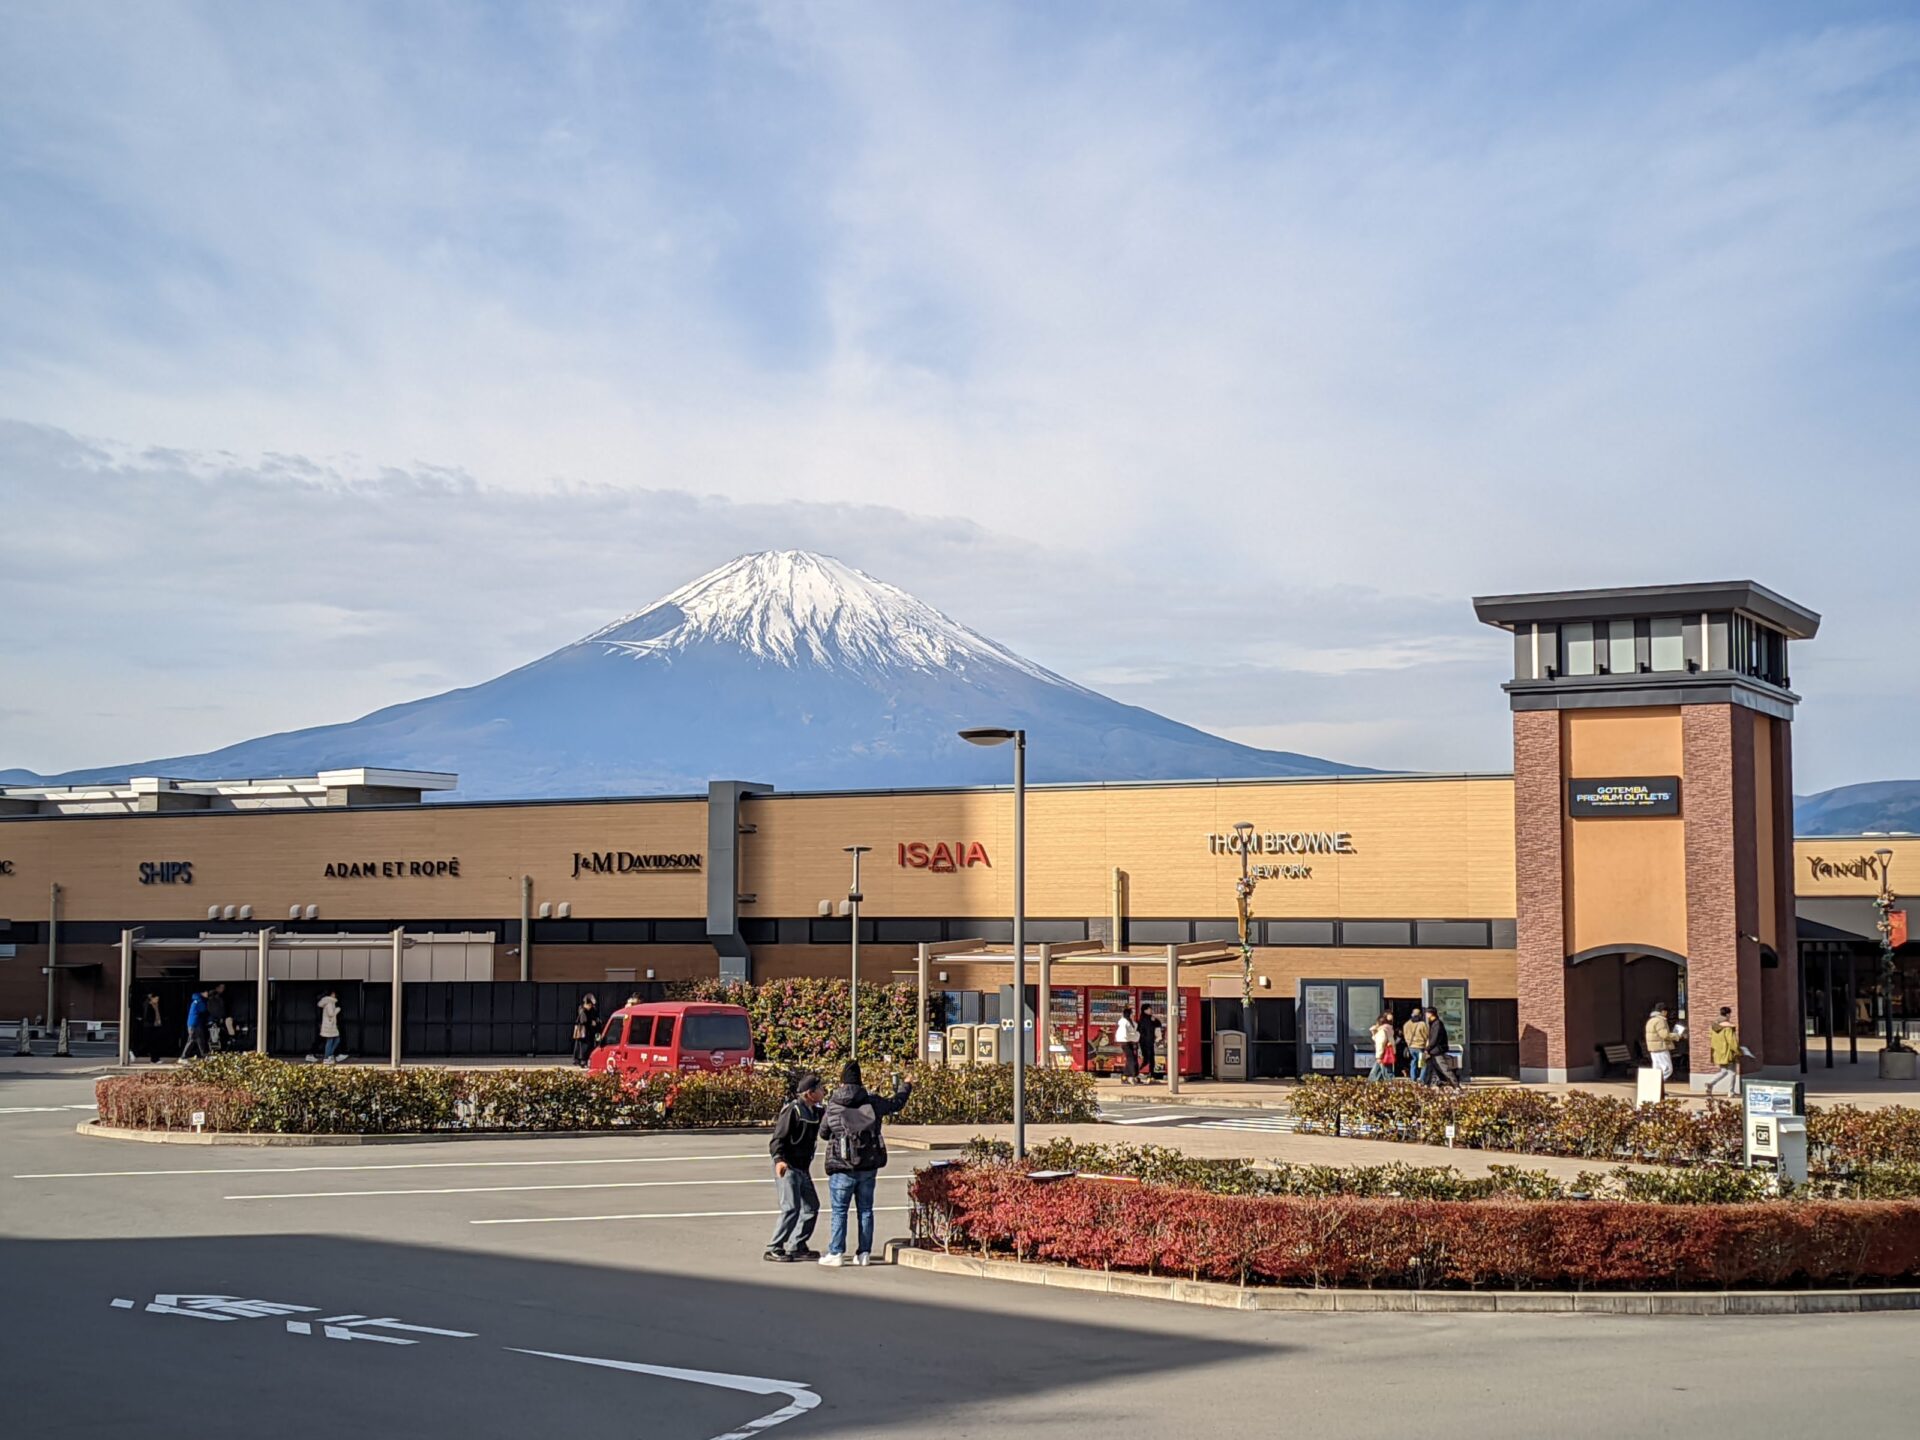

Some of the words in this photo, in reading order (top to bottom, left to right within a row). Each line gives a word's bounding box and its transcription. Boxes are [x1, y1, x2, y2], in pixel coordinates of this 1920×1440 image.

[898, 841, 992, 868] ISAIA
[138, 861, 194, 885] SHIPS
[324, 862, 376, 878] ADAM
[382, 861, 404, 878] ET
